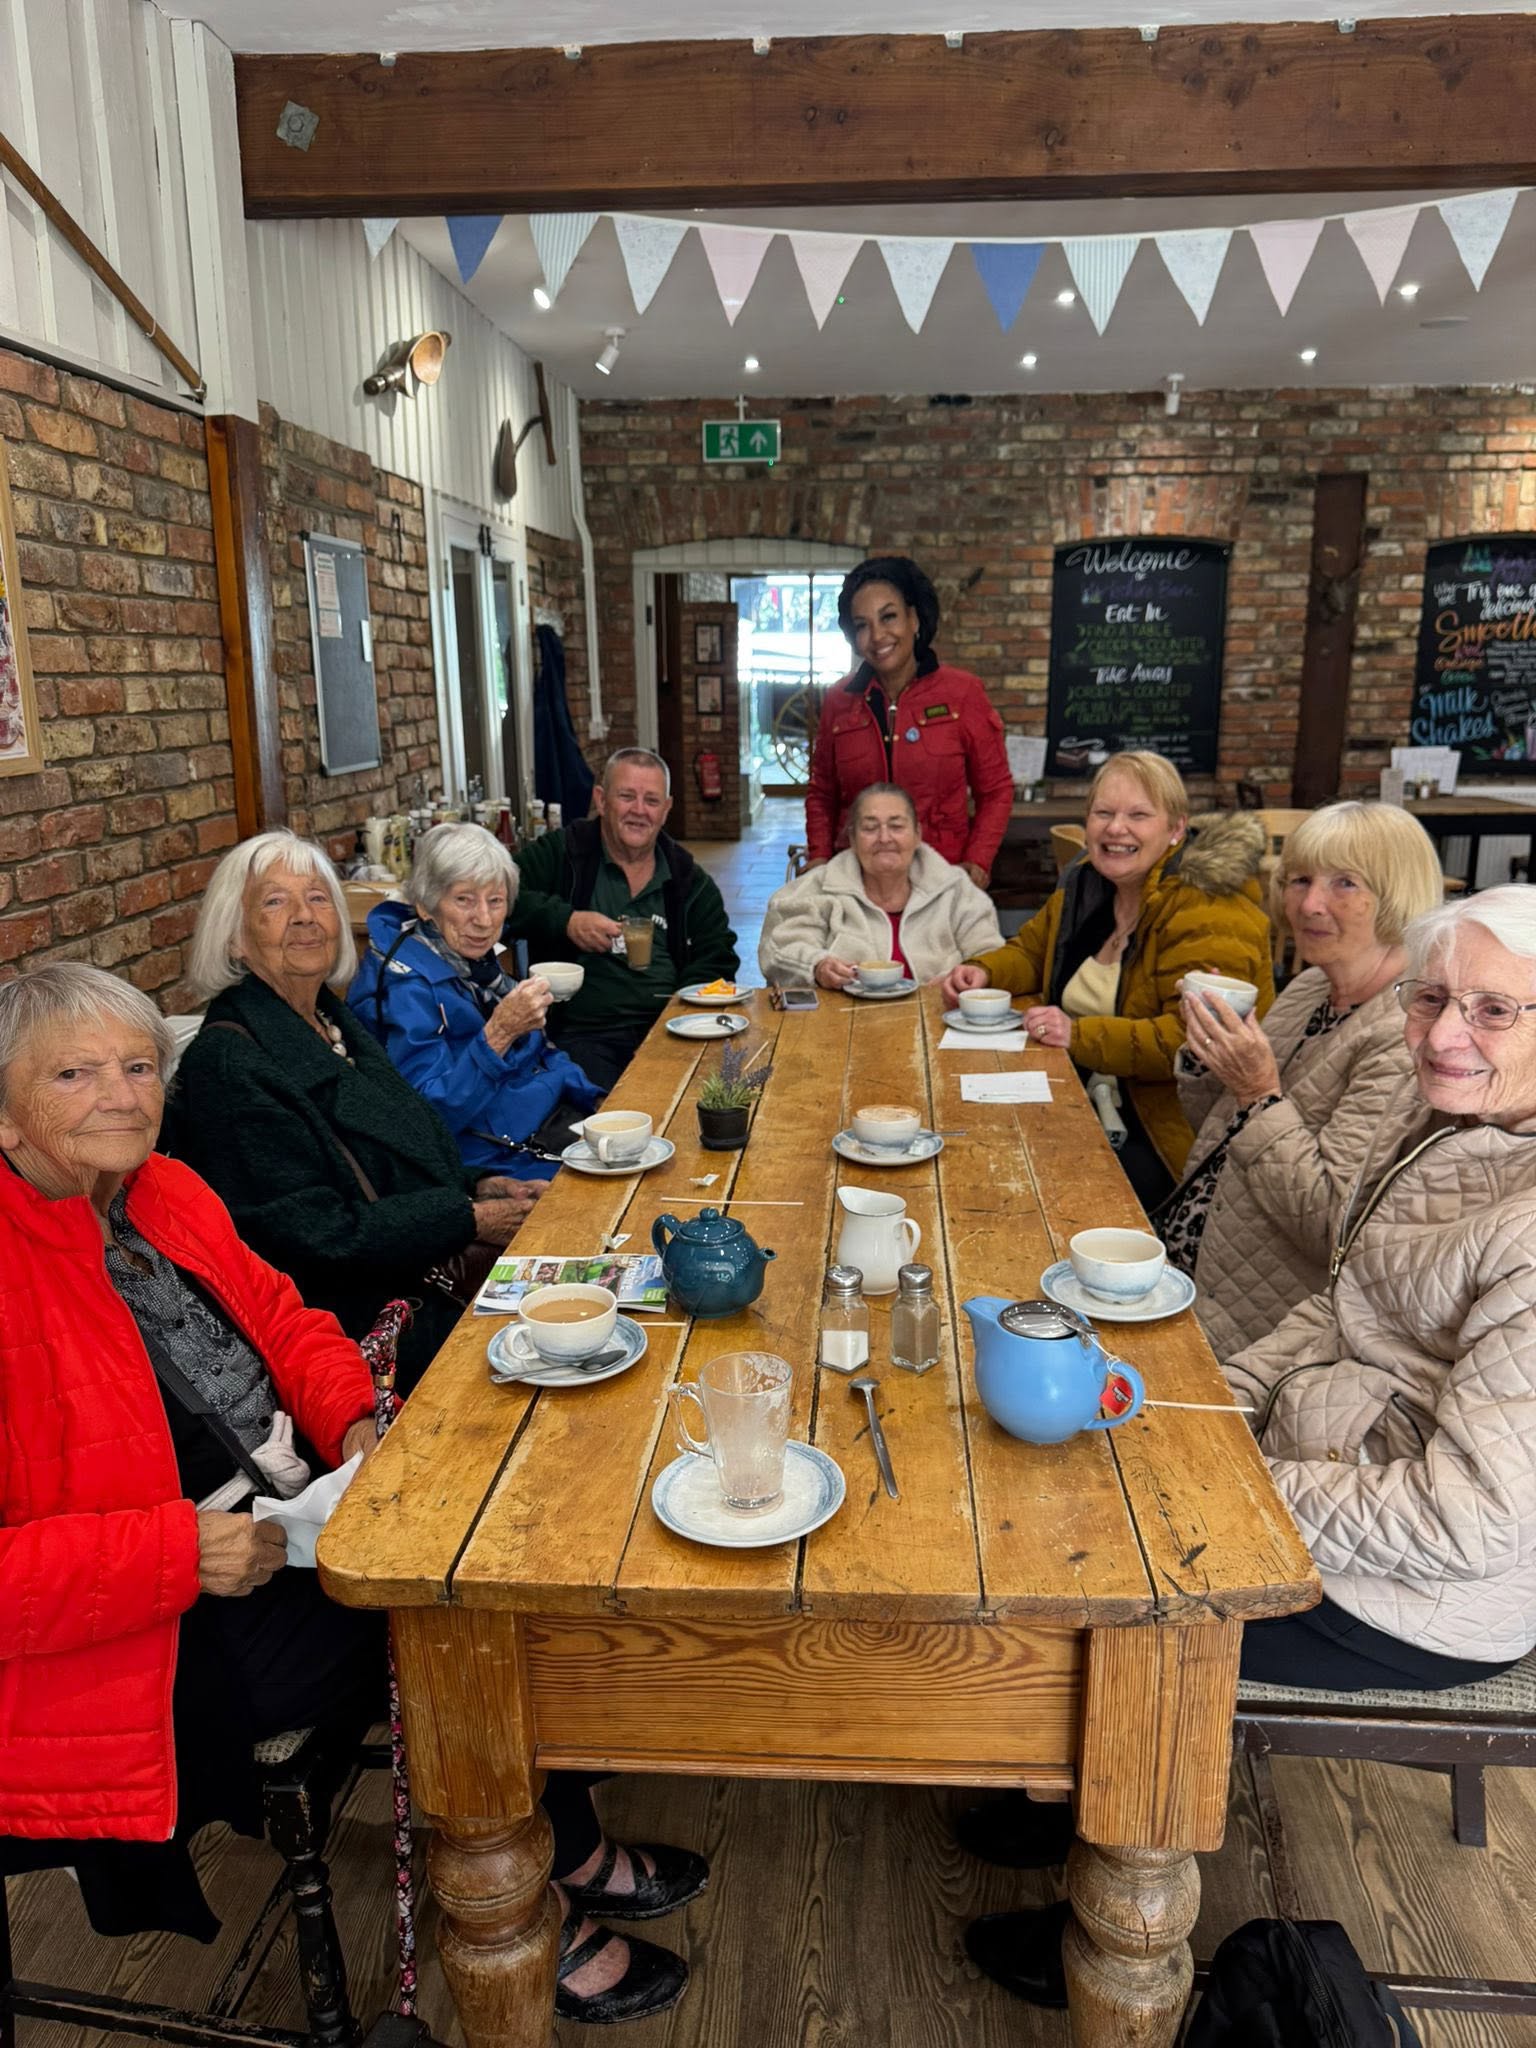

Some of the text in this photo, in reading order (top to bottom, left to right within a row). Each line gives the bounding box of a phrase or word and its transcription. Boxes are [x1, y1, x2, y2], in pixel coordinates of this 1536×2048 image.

[1065, 542, 1201, 575] Welcome
[1461, 580, 1491, 602] Try
[1497, 583, 1526, 598] one
[1105, 601, 1170, 624] Eat In
[1089, 662, 1173, 685] Take Away
[1419, 686, 1488, 719] Milk
[1411, 710, 1497, 745] Shakes
